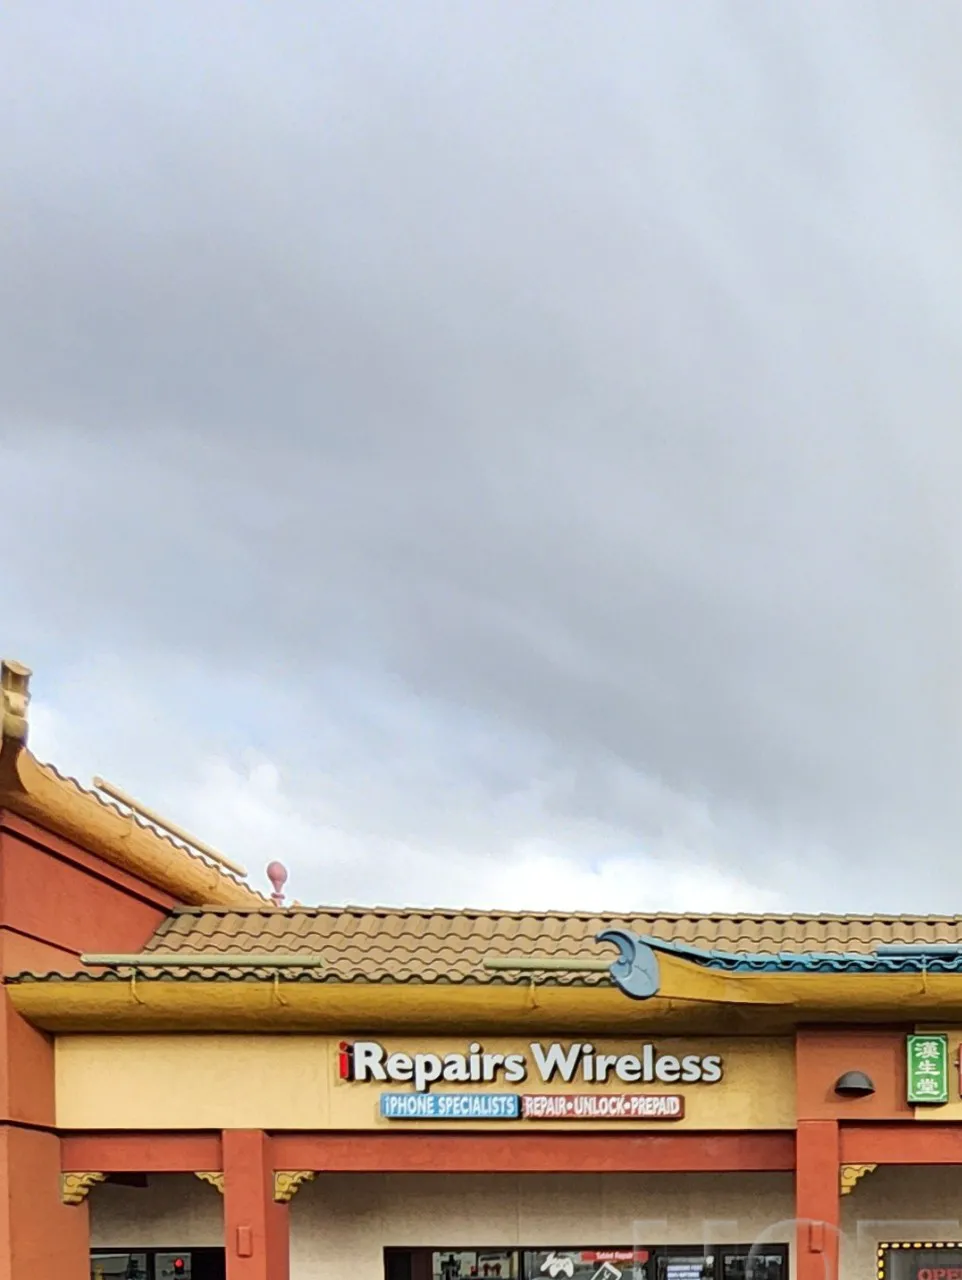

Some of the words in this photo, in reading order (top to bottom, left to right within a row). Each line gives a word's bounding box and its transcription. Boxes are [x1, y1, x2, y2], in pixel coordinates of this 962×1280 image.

[339, 1041, 526, 1093] iRepairs
[529, 1042, 723, 1083] Wireless
[438, 1096, 515, 1116] SPECIALISTS
